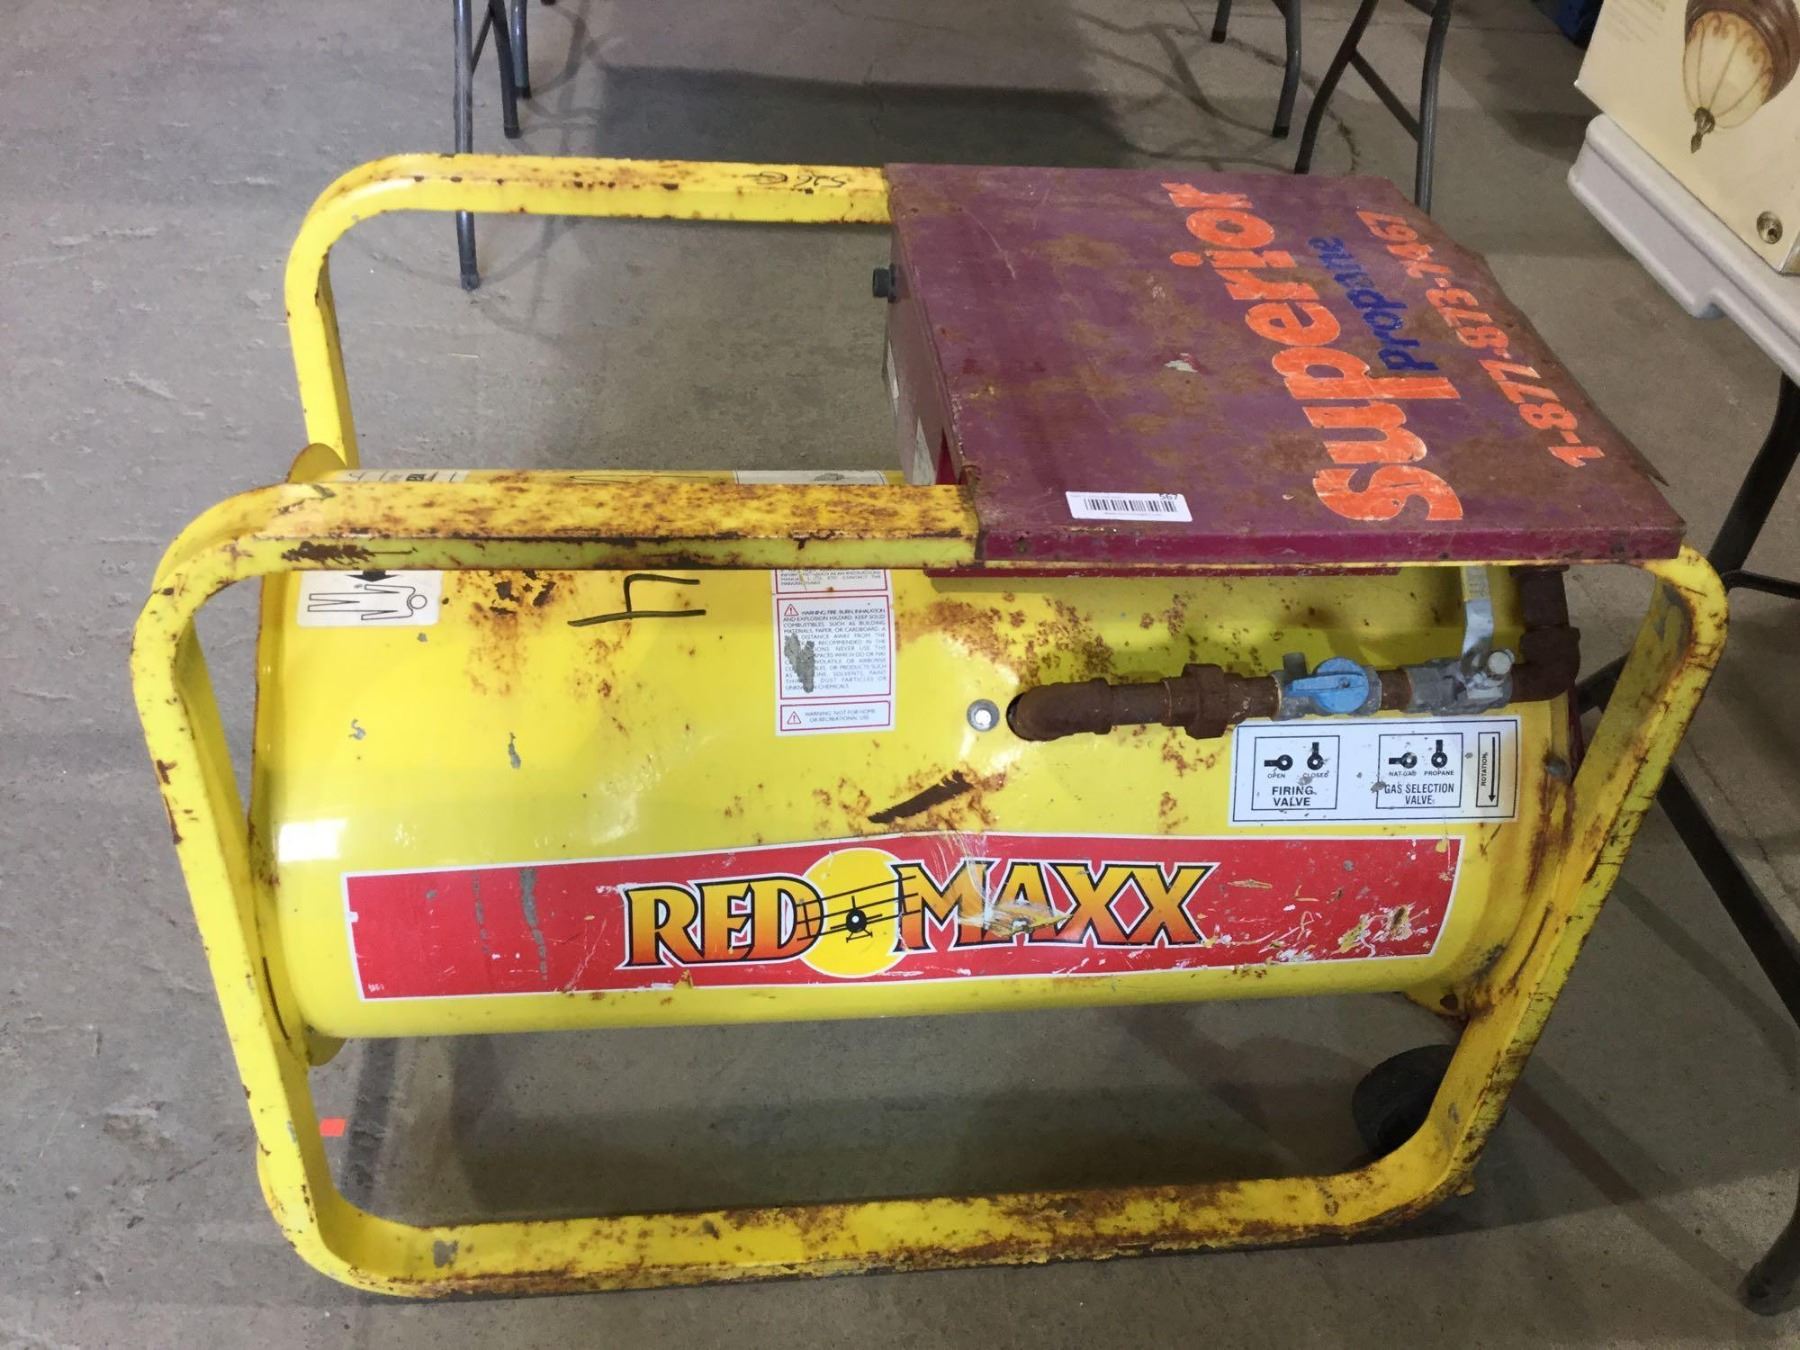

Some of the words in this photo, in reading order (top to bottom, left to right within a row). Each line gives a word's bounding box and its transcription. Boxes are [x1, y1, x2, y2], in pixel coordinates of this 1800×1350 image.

[1308, 236, 1439, 371] Propane
[1161, 182, 1464, 521] Superior
[1355, 211, 1605, 468] 1-877-873-7467
[1272, 786, 1314, 796] FIRING
[1273, 797, 1311, 806] VALVE
[1384, 784, 1402, 794] GAS
[1405, 783, 1454, 794] SELECTION
[1405, 795, 1432, 804] VALVE
[622, 875, 825, 969] RED
[891, 858, 1222, 952] MAXX
